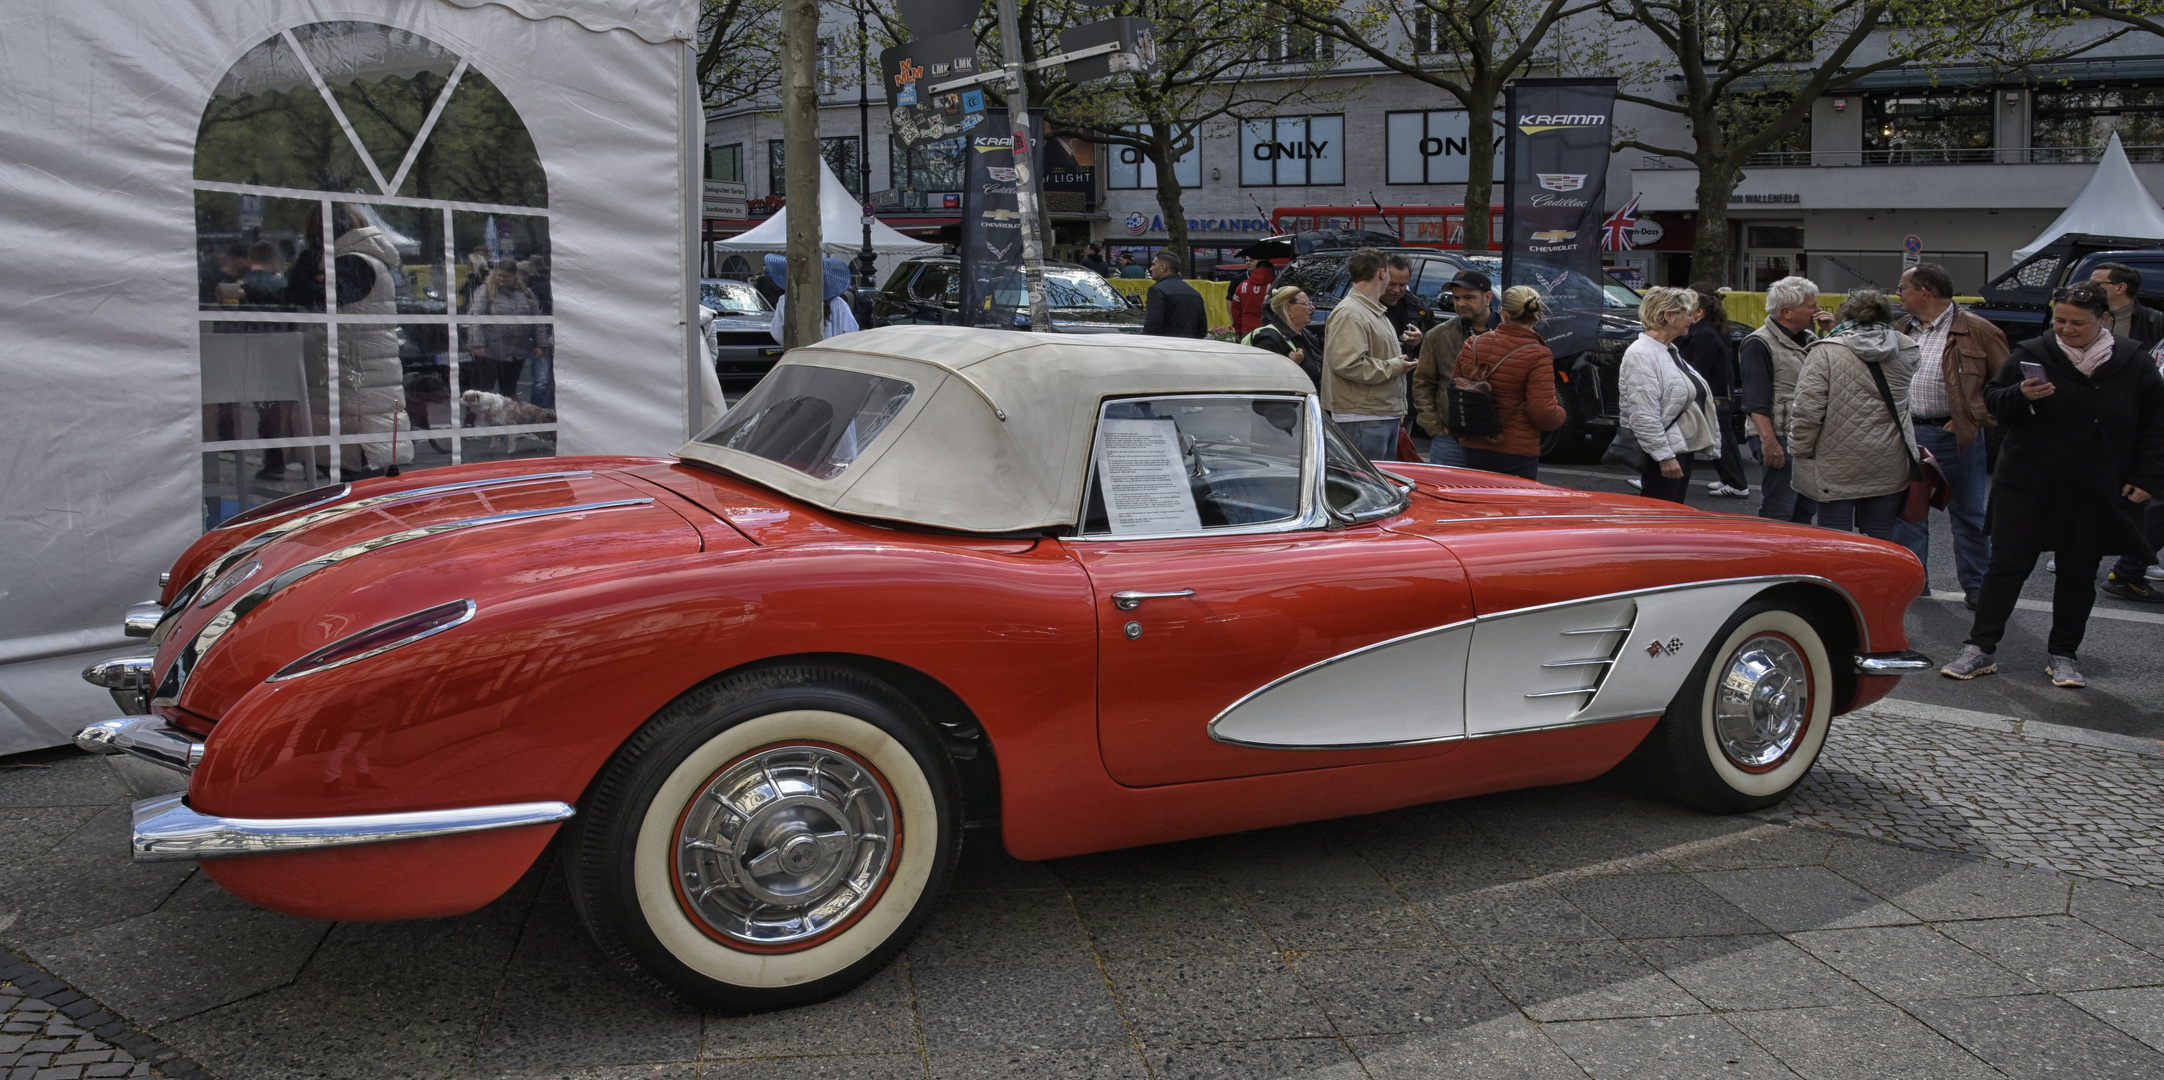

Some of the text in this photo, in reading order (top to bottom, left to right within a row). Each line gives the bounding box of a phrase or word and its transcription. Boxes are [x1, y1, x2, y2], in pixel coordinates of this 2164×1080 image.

[954, 57, 972, 69] LMK
[931, 63, 950, 75] LMK
[1519, 114, 1605, 125] KRAMM
[974, 137, 1036, 147] KRA
[1419, 136, 1505, 156] ONY
[1253, 141, 1328, 161] ONLY
[1054, 173, 1091, 183] LIGHT
[704, 186, 745, 195] Zoologischer Garten
[982, 183, 1017, 194] Cadilla
[1530, 193, 1589, 208] Cadillac
[1745, 193, 1800, 204] WALLENFELS
[705, 206, 743, 215] Joachimstaler Str.
[981, 221, 1021, 229] CHEVROLET
[1631, 228, 1660, 236] en-Dazs
[1529, 244, 1578, 252] CHEVROLET
[1128, 286, 1148, 296] Mak
